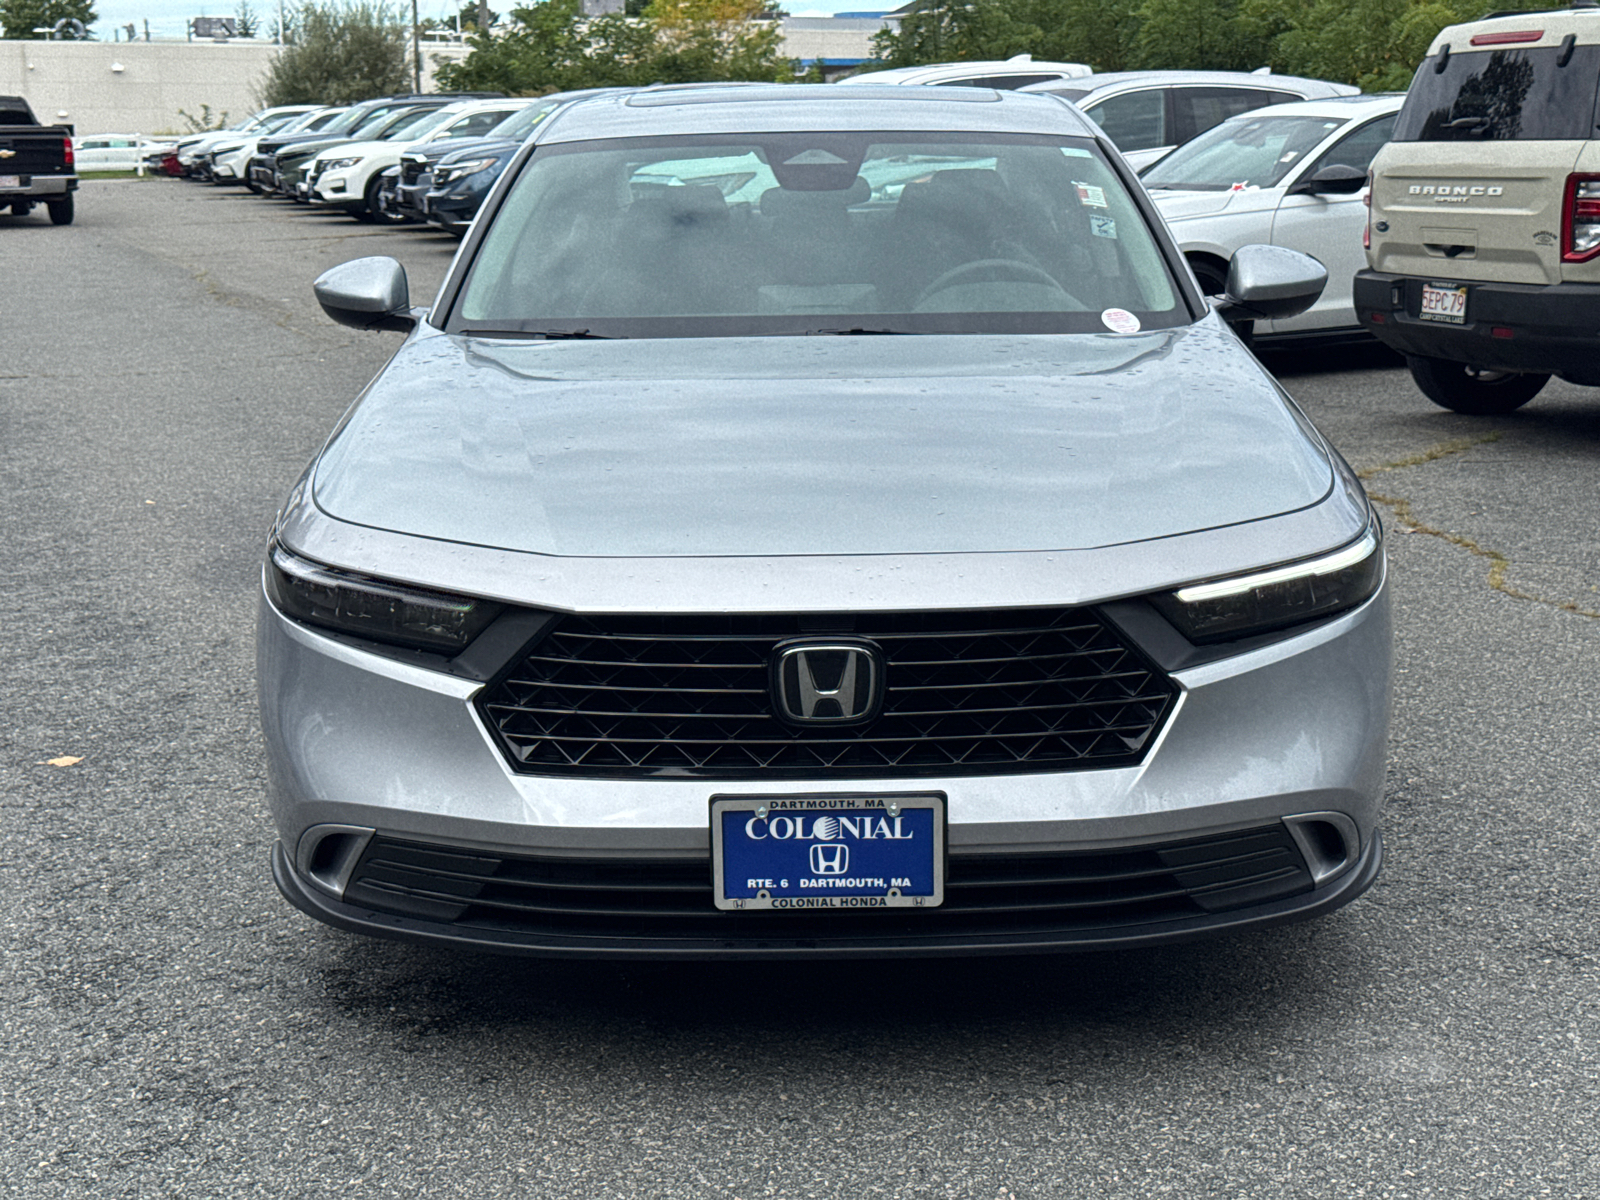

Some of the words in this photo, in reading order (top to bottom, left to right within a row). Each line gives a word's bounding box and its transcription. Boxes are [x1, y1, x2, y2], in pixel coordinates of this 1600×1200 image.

[1409, 185, 1503, 196] BRONCO
[864, 799, 885, 808] MA
[747, 878, 777, 888] RTE.
[780, 878, 789, 888] 6
[800, 878, 887, 889] DARTMOUTH,
[891, 878, 912, 887] MA
[771, 898, 836, 908] COLONIAL
[840, 897, 887, 907] HONDA
